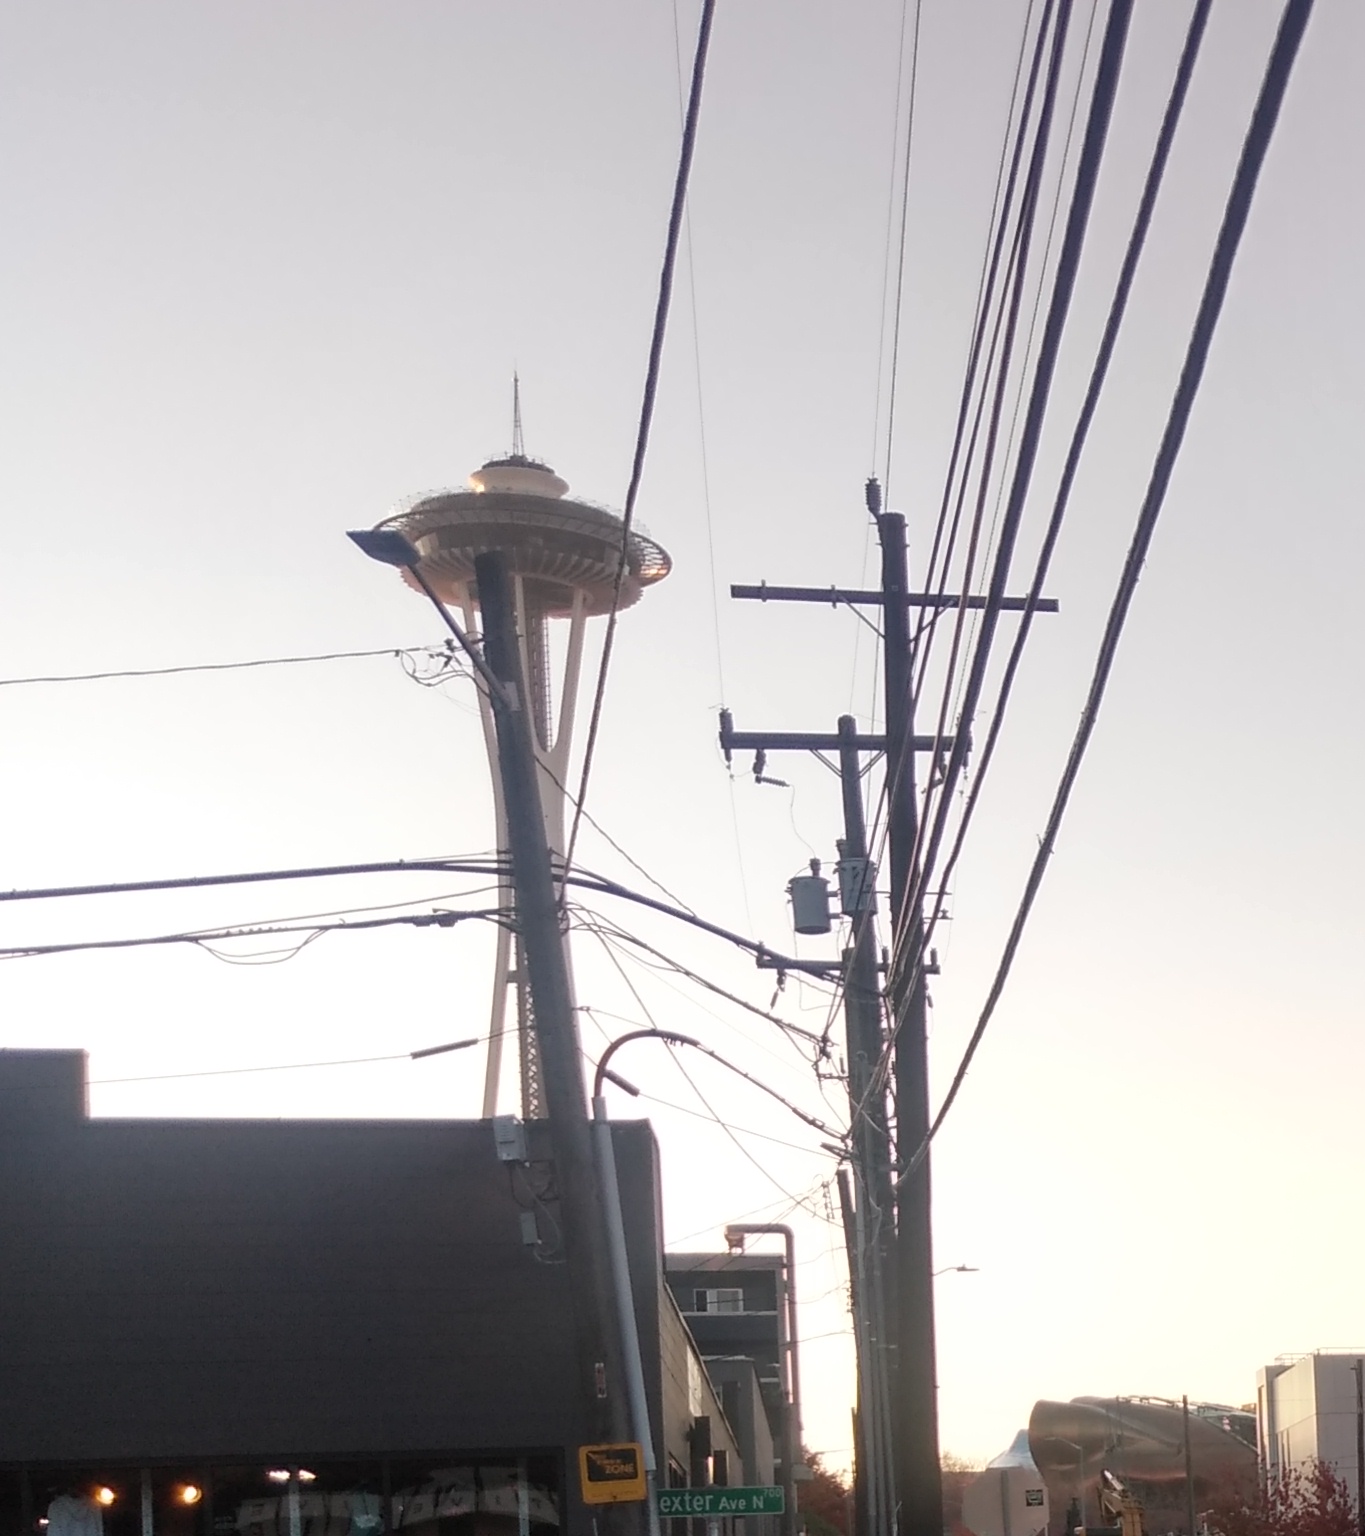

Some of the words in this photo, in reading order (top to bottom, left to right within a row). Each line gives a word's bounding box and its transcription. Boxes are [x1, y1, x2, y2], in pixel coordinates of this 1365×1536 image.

[605, 1463, 635, 1474] ZONE
[763, 1489, 782, 1498] 700
[659, 1491, 714, 1513] exter
[718, 1498, 746, 1511] Ave
[752, 1496, 764, 1509] N
